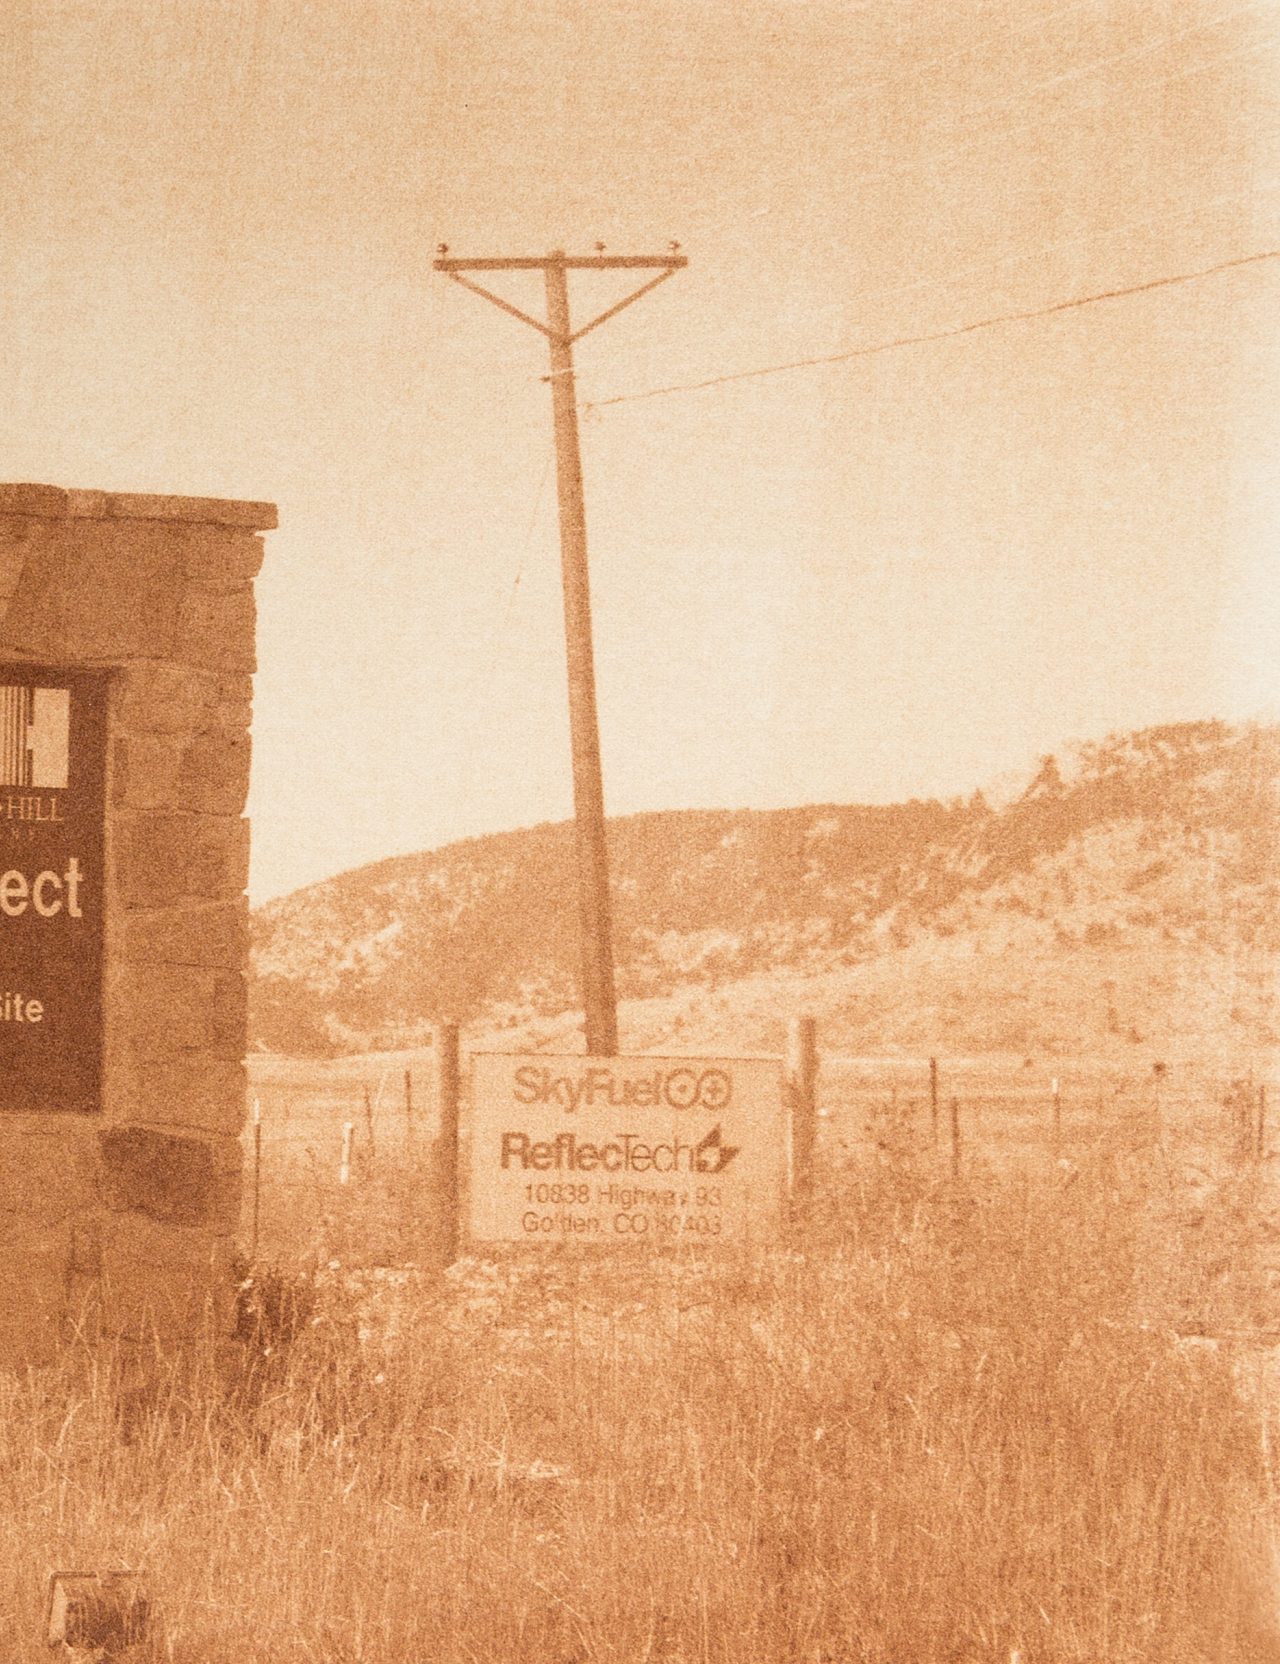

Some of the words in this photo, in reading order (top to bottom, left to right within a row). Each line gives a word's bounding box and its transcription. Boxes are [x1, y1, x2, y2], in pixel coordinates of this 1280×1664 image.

[513, 1065, 664, 1114] SkyFuel
[501, 1131, 696, 1173] ReflecTech
[524, 1183, 590, 1205] 10838
[696, 1186, 722, 1208] 93
[613, 1212, 649, 1235] CO
